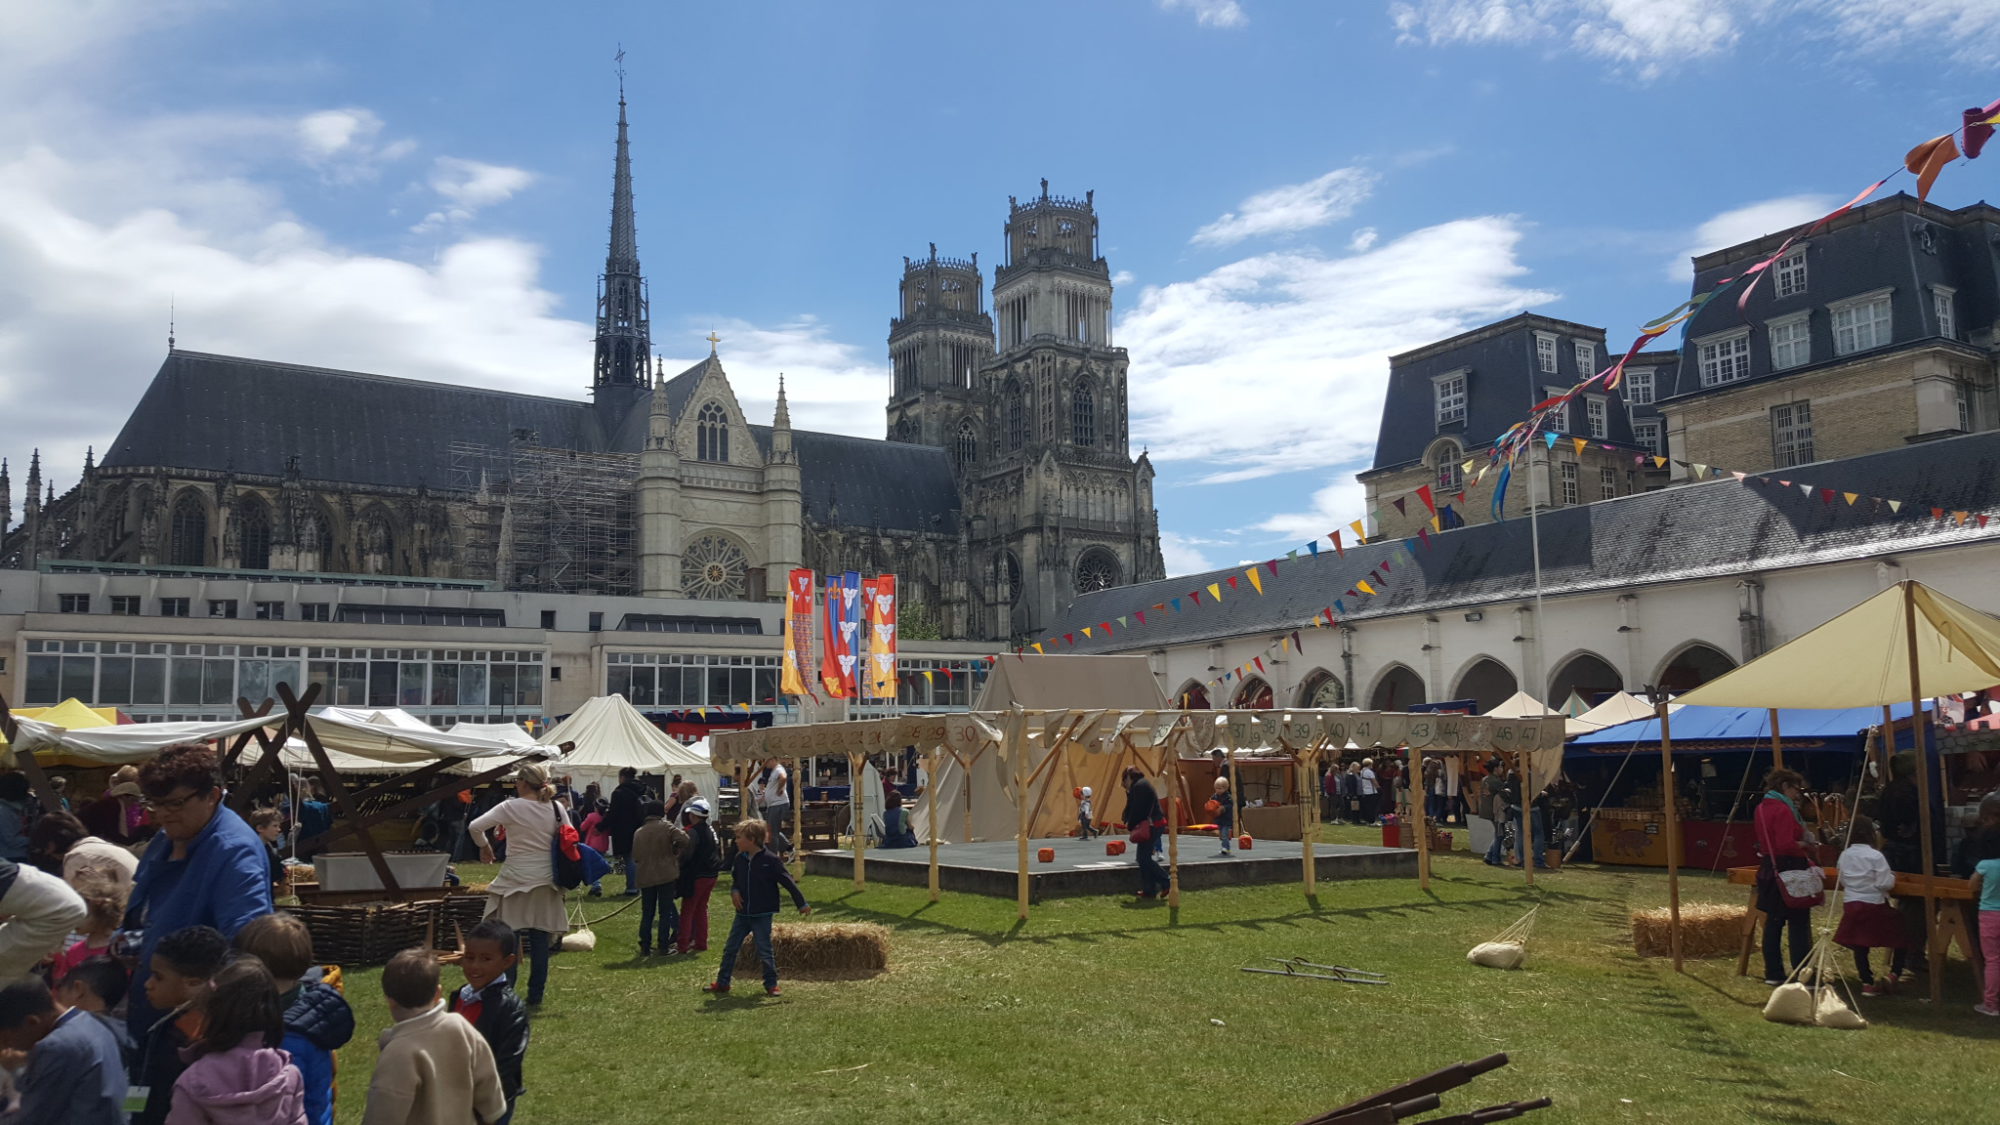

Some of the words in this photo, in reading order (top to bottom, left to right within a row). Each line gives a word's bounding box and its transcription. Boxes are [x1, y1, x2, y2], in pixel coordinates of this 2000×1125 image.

[926, 726, 945, 740] 29
[954, 725, 976, 742] 30
[1231, 723, 1246, 738] 37
[1262, 719, 1277, 734] 38
[1294, 723, 1310, 739] 39
[1329, 722, 1345, 737] 40
[1356, 722, 1371, 737] 41
[1411, 723, 1429, 738] 43
[1443, 722, 1459, 737] 44
[1496, 726, 1513, 741] 46
[1521, 727, 1536, 740] 47
